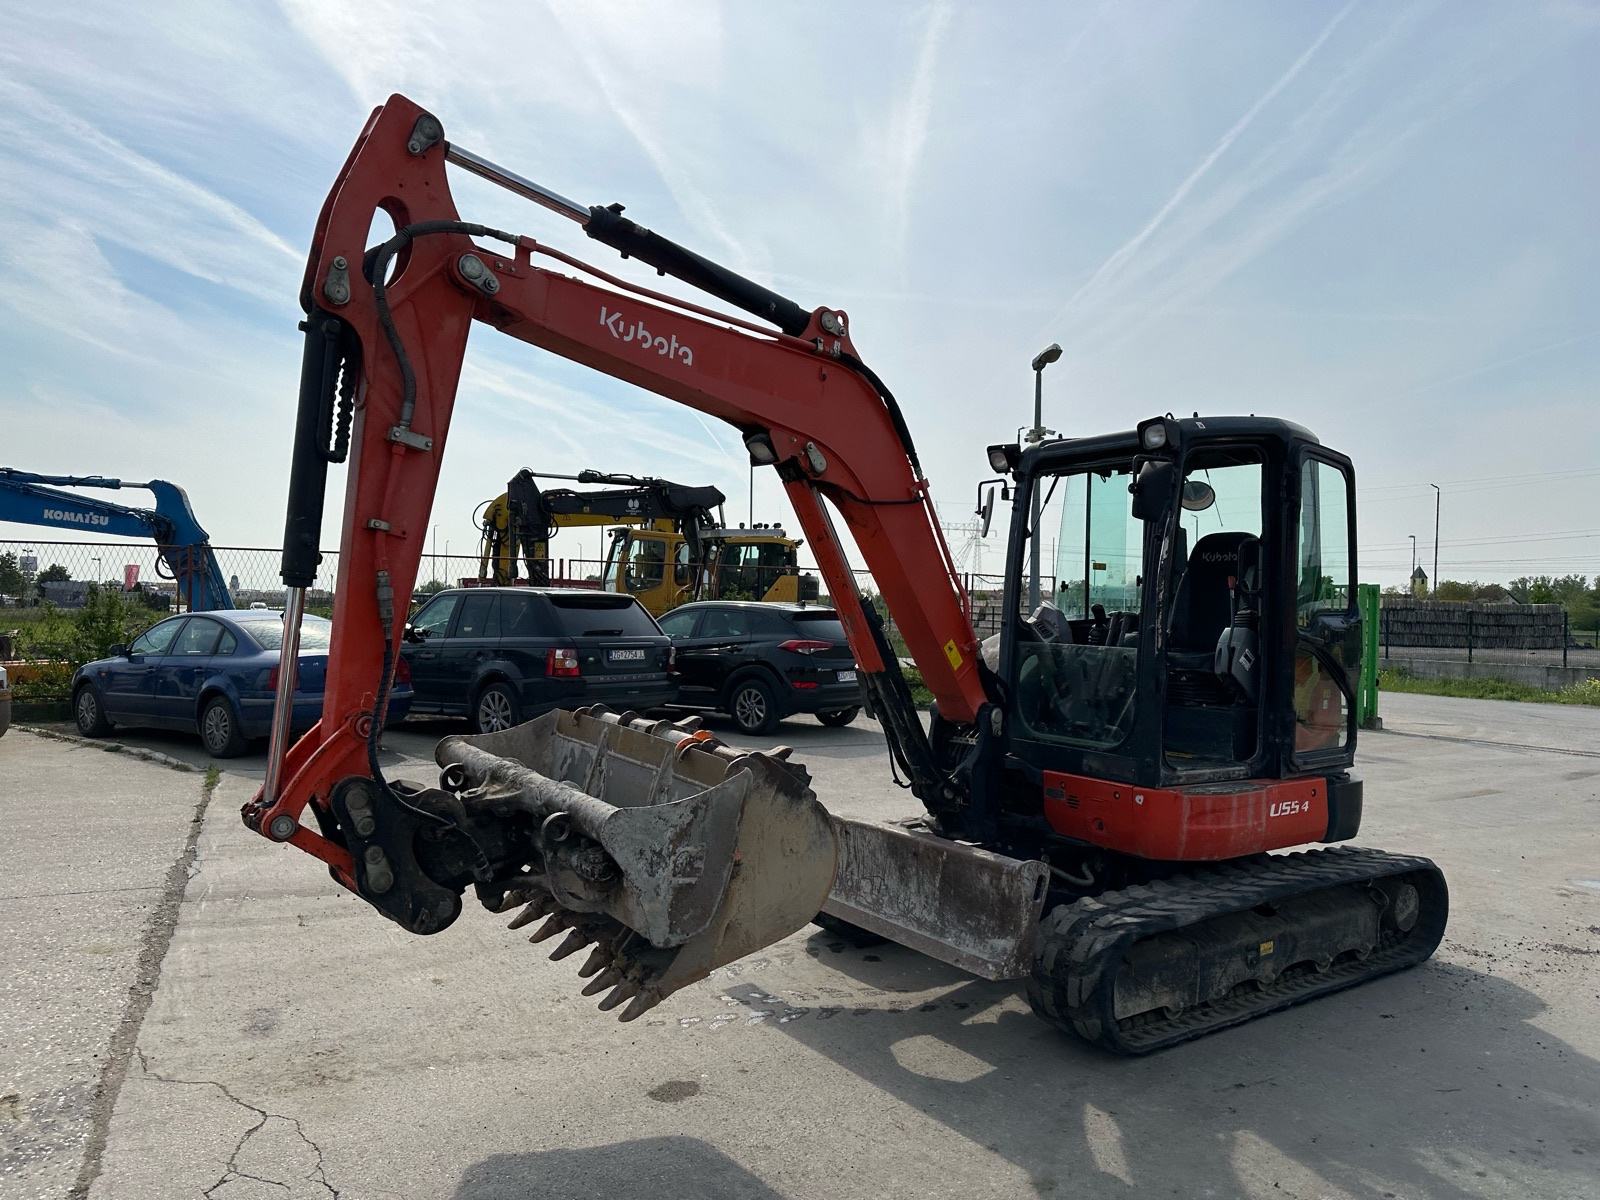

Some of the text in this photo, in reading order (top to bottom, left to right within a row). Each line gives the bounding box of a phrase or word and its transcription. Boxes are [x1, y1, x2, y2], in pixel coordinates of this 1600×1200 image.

[600, 306, 693, 367] Kubota
[43, 508, 109, 526] KOMATSU
[1202, 551, 1238, 562] Kubota
